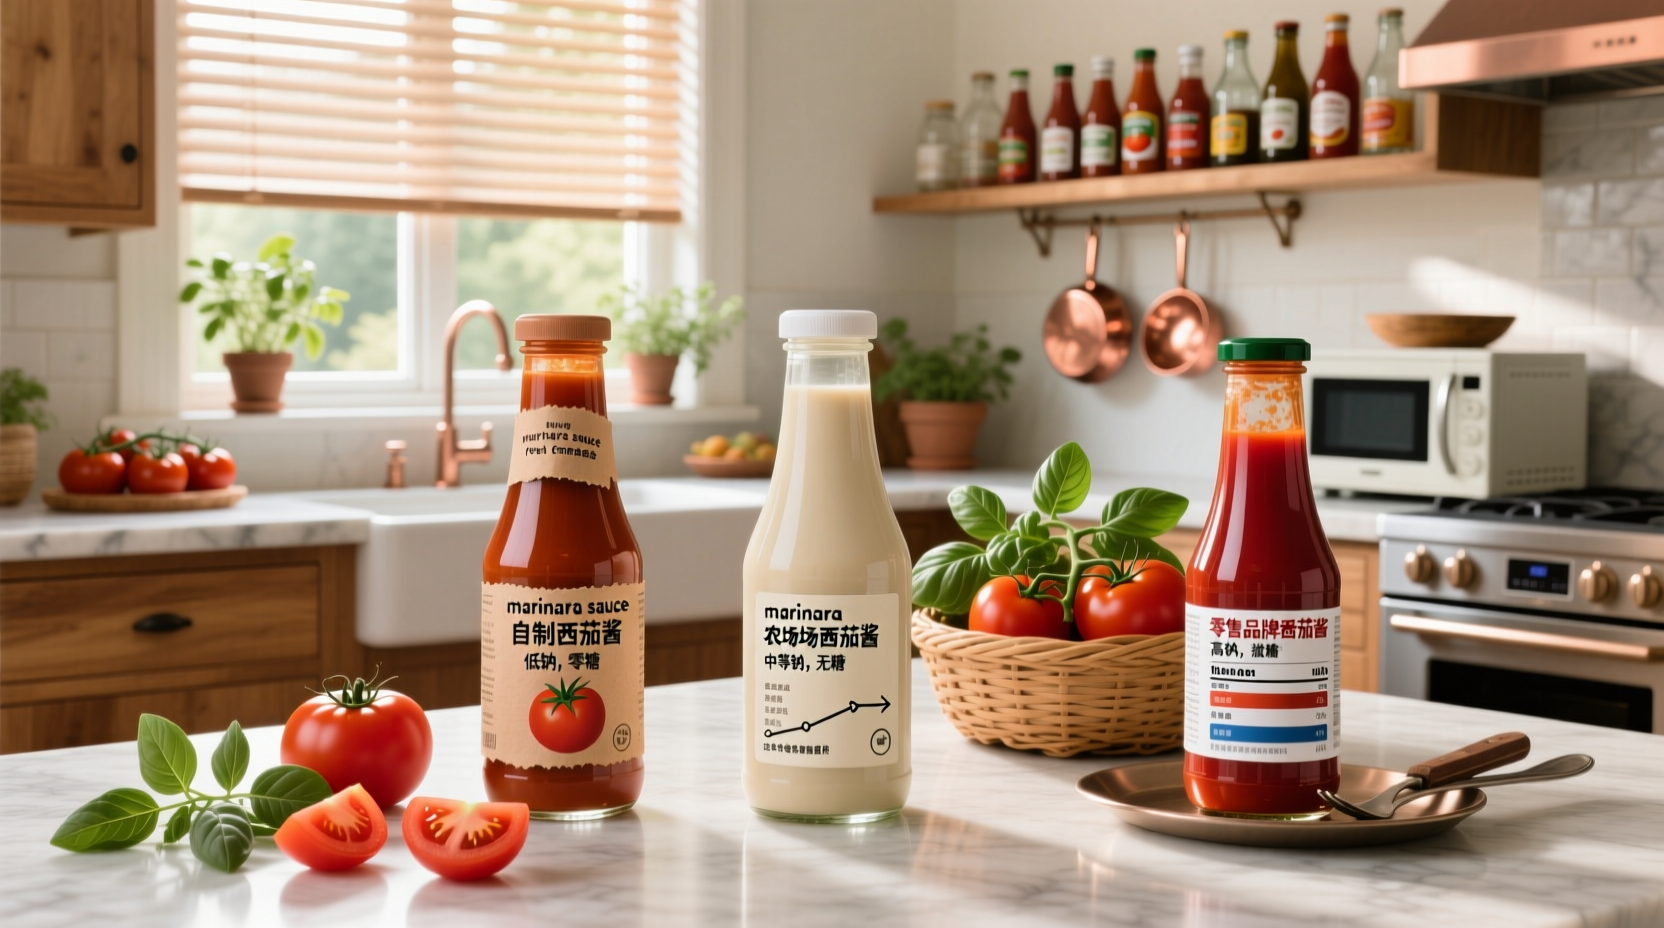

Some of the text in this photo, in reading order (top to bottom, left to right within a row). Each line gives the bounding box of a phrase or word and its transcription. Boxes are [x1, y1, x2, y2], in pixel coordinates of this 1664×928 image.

[507, 597, 630, 615] marinara sauce
[764, 602, 843, 621] marinara
[512, 618, 623, 647] 自制西茄酱
